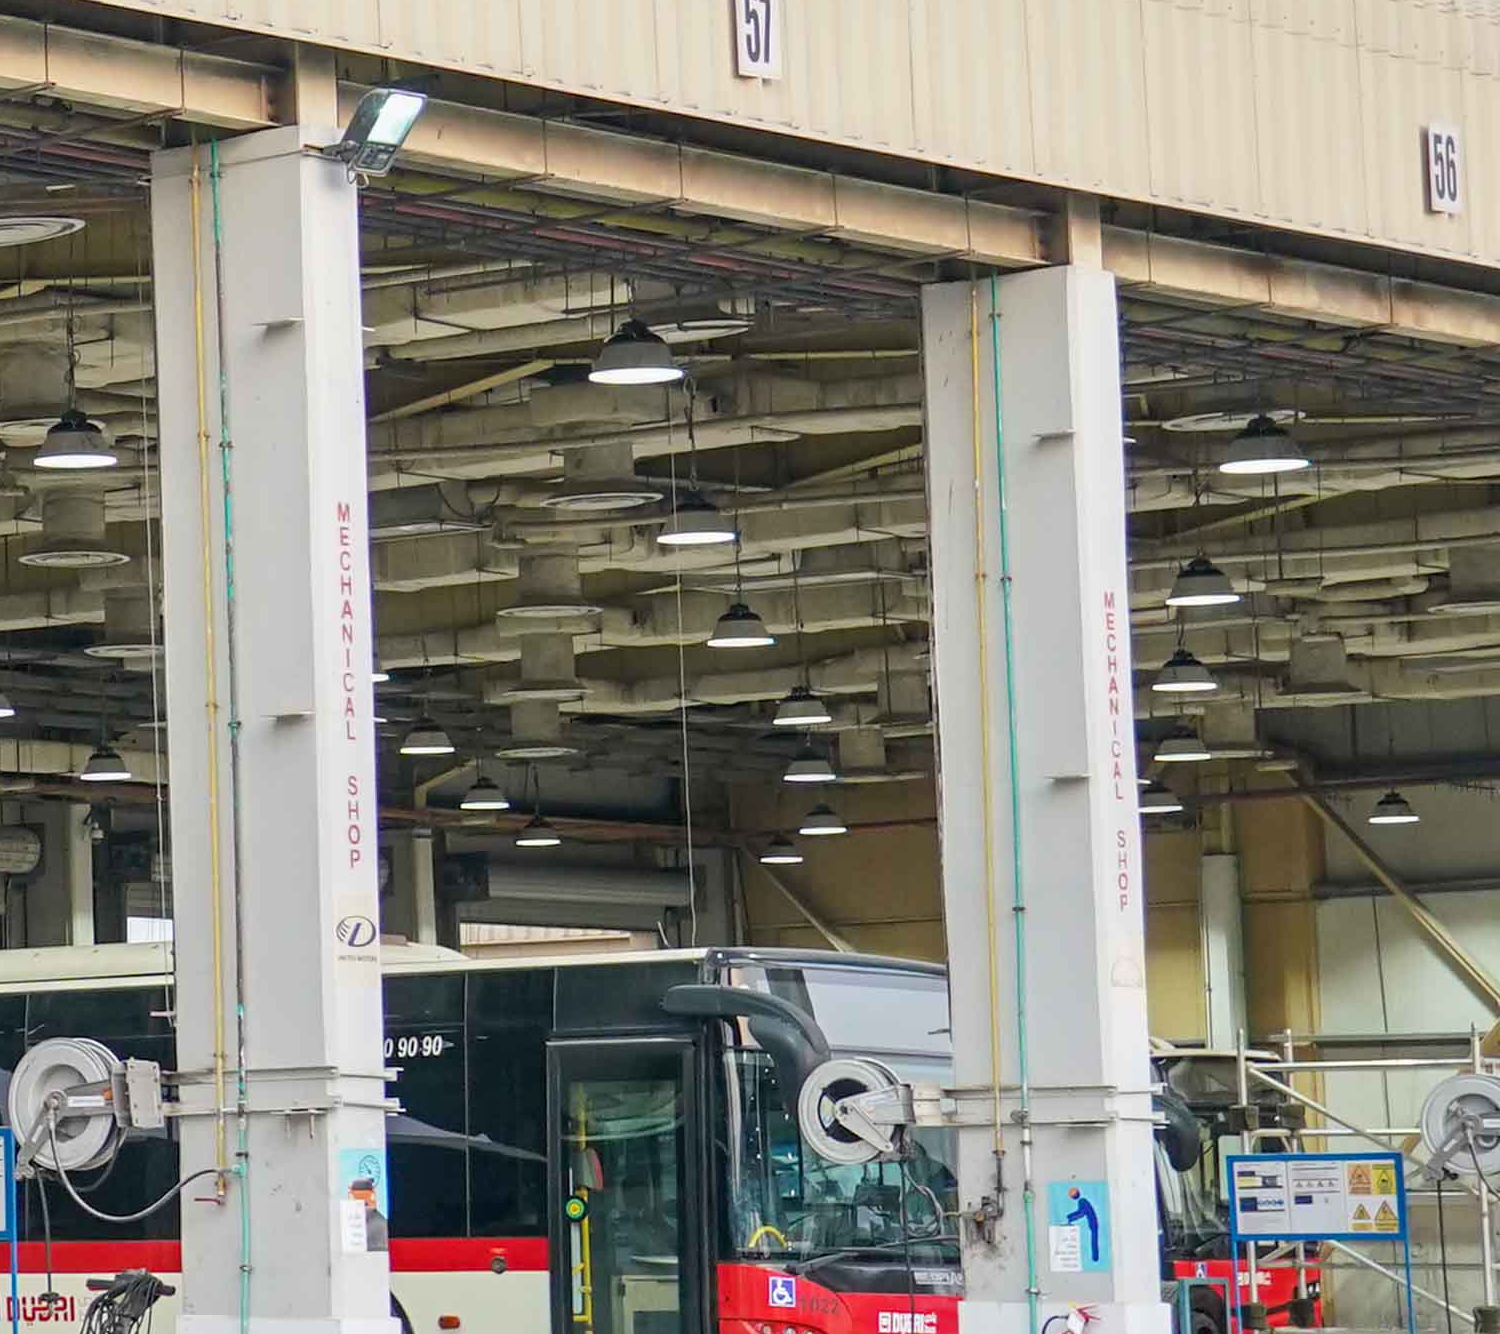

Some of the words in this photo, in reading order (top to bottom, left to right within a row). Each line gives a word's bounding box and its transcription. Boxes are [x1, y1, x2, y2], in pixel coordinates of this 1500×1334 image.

[1433, 133, 1457, 202] 56
[337, 502, 357, 741] MECHANICAL
[347, 775, 362, 869] SHOP
[1103, 591, 1125, 801] MECHANICAL
[1116, 829, 1130, 911] SHOP
[397, 1036, 418, 1058] 90
[422, 1034, 443, 1056] 90
